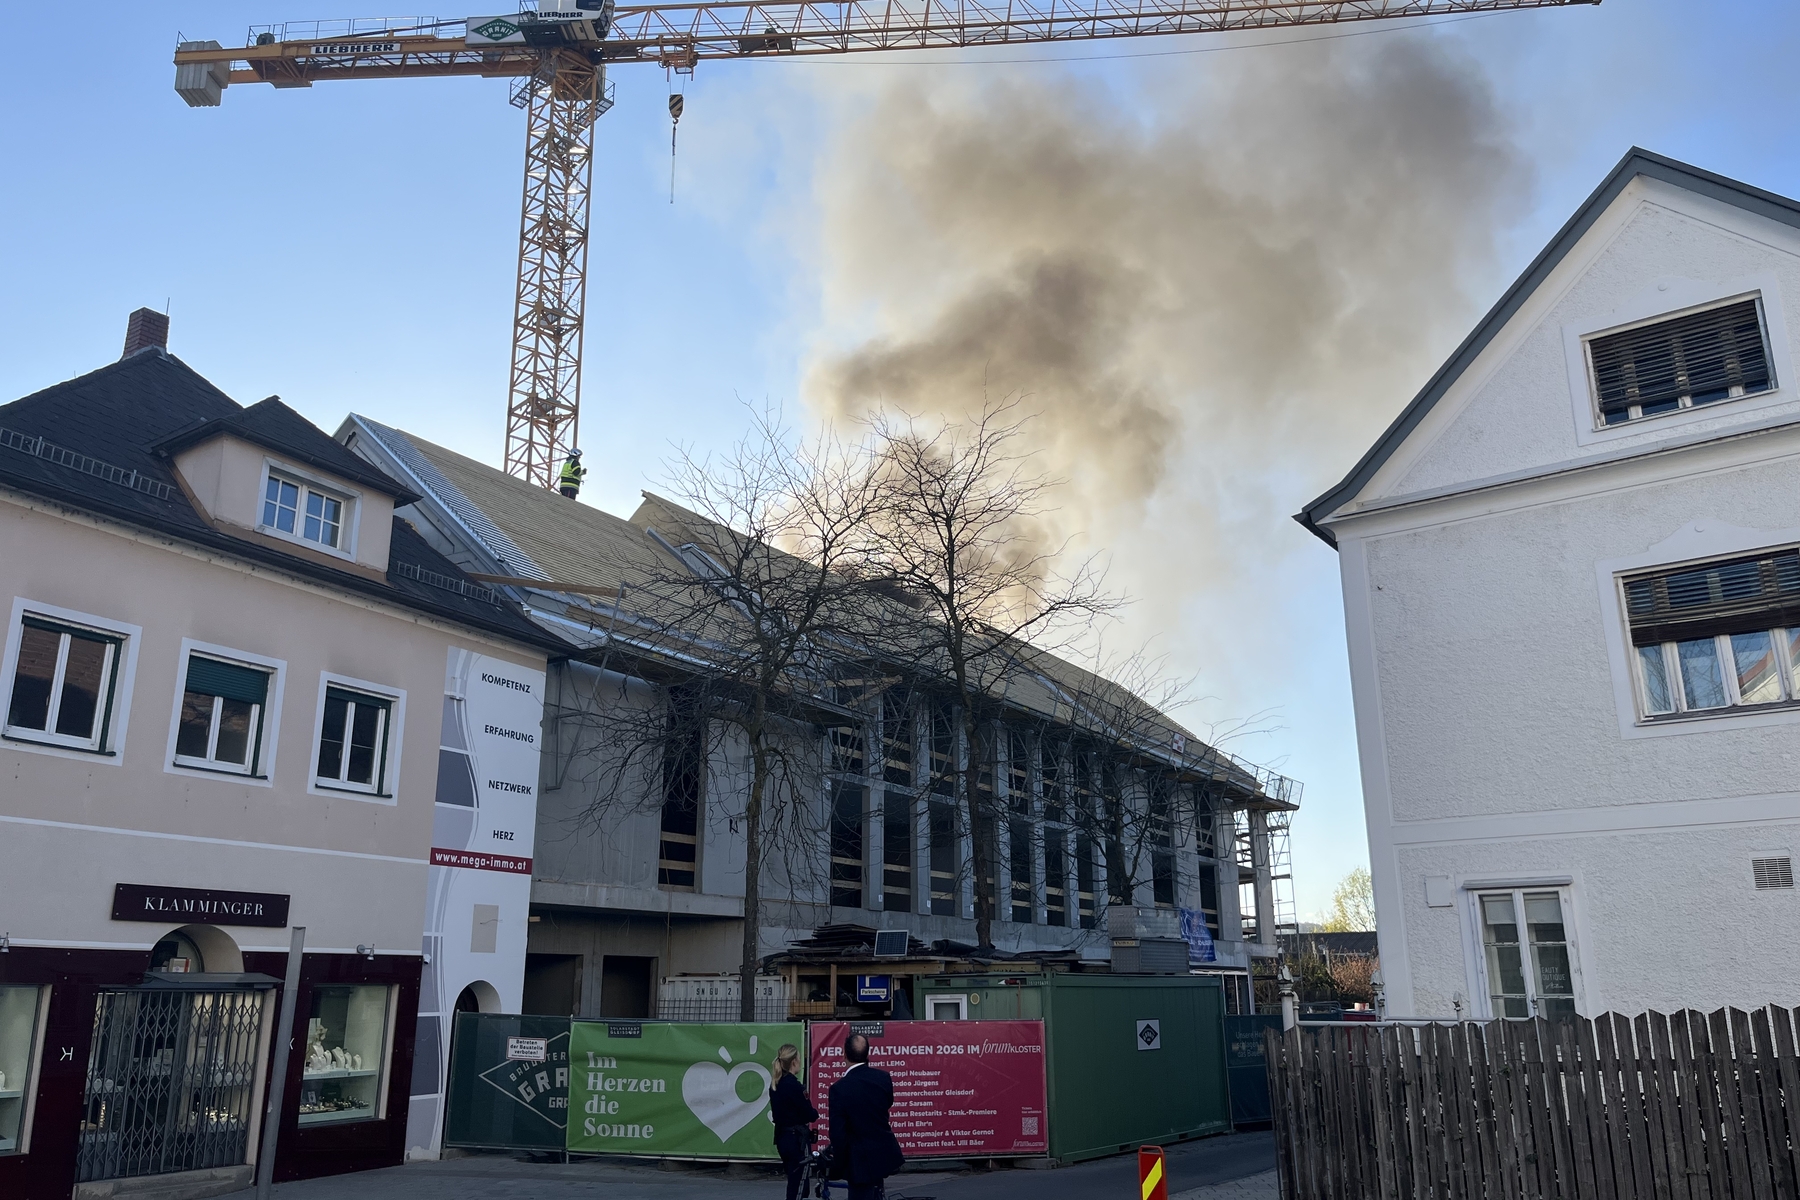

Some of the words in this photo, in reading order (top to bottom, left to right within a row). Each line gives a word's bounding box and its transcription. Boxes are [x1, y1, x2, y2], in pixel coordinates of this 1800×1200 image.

[315, 43, 395, 54] LIEBHERR
[481, 672, 531, 694] KOMPETENZ
[484, 724, 534, 744] ERFAHRUNG
[488, 780, 532, 796] NETZWERK
[492, 830, 514, 841] HERZ
[435, 852, 527, 871] www.mega-immo.at
[144, 897, 264, 916] KLAMMINGER
[936, 1045, 964, 1055] 2026
[967, 1045, 980, 1054] IM
[586, 1051, 617, 1069] Im
[586, 1072, 666, 1093] Herzen
[889, 1070, 908, 1078] Seppi
[518, 1067, 568, 1103] GRA
[584, 1094, 619, 1115] die
[584, 1117, 654, 1139] Sonne
[912, 1131, 944, 1139] Kopmajer
